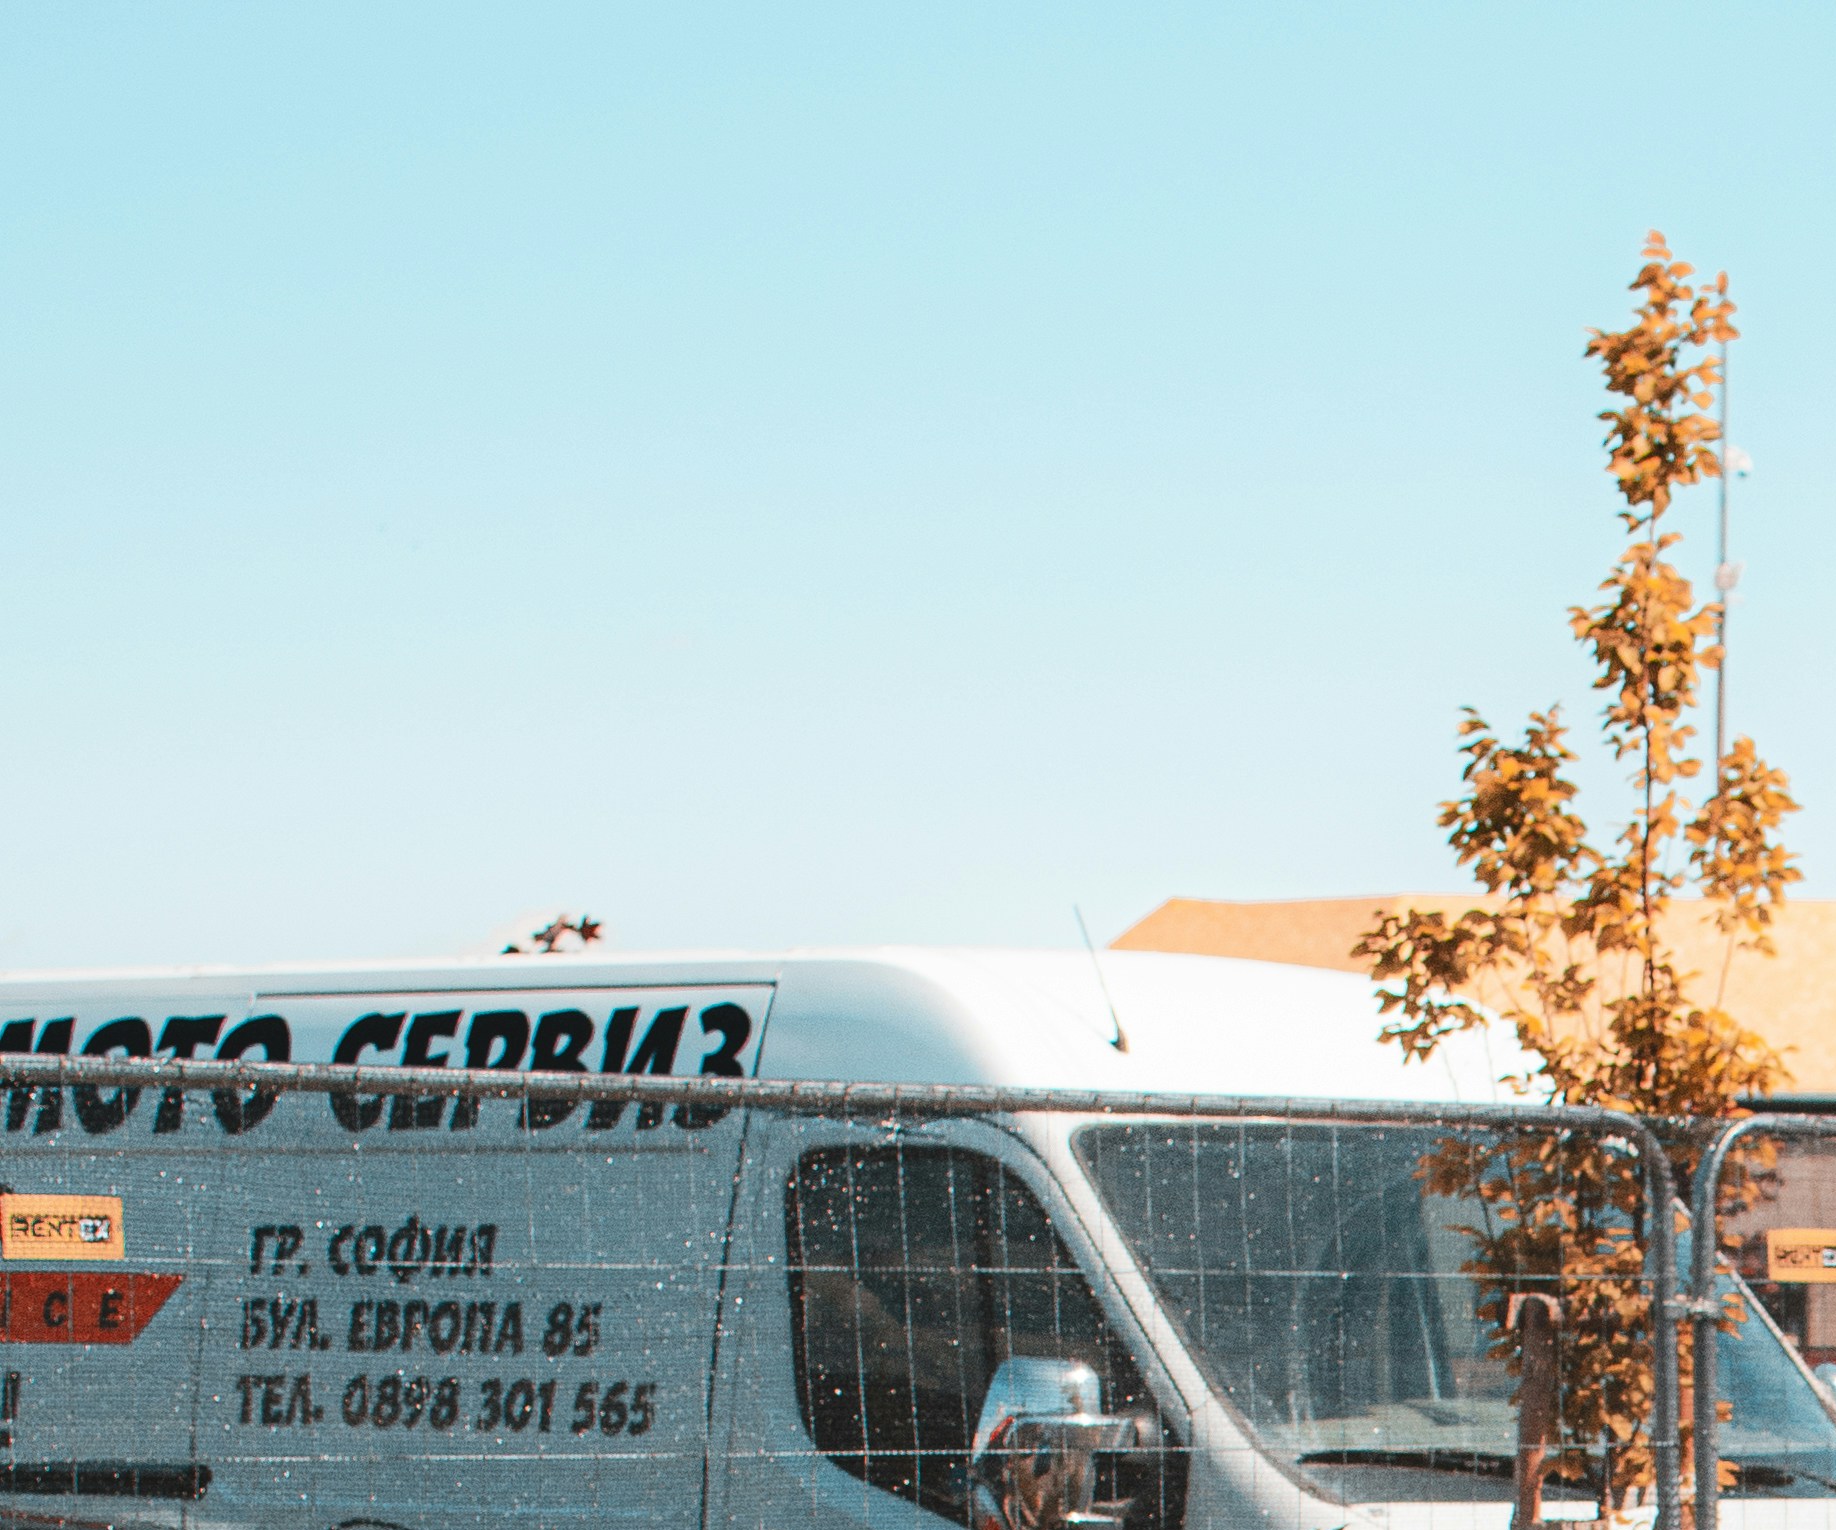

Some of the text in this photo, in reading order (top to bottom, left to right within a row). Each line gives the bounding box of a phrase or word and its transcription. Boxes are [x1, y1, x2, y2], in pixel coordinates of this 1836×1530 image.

[329, 1002, 753, 1133] СЕРВИЗ
[347, 1299, 525, 1356] ЕВРОПА
[541, 1301, 602, 1356] 85
[476, 1377, 557, 1434] 301
[571, 1380, 658, 1437] 565
